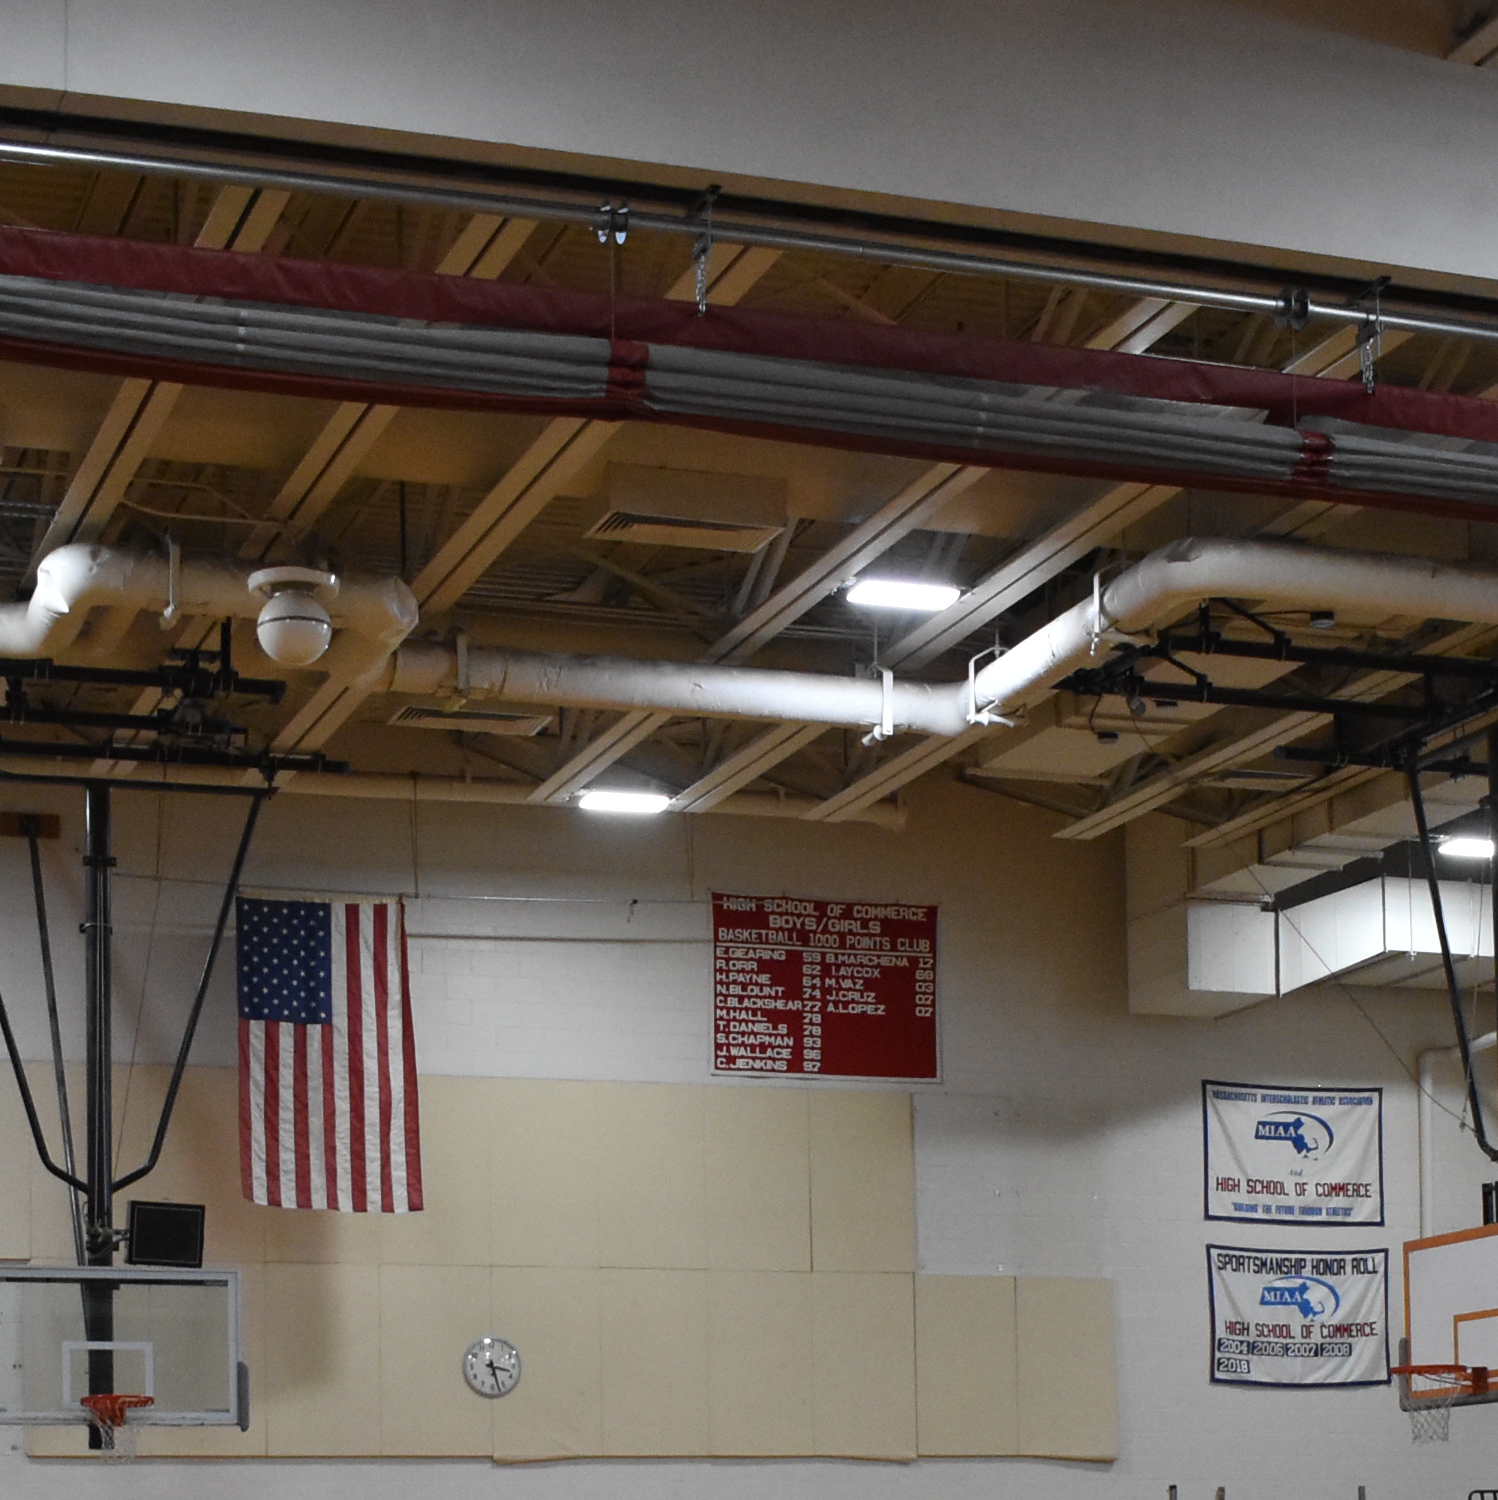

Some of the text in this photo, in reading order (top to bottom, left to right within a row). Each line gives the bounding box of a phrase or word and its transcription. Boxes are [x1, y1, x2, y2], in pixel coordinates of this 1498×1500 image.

[723, 897, 927, 921] HIGH SCHOOL OF COMMERCE
[769, 915, 881, 934] BOYS/GIRLS
[719, 928, 929, 952] BASKETBALL 1000 POINTS CLUB
[803, 976, 821, 988] 64
[1258, 1125, 1296, 1137] MIAA
[1216, 1177, 1371, 1197] HIGH SCHOOL OF COMMERCE
[1217, 1253, 1378, 1275] SPORTSMANSHIP HONOR ROLL
[1263, 1290, 1301, 1302] MIAA
[1225, 1321, 1378, 1339] HIGH SCHOOL OF COMMERCE
[1220, 1340, 1248, 1353] 2004
[1287, 1343, 1316, 1355] 2007
[1219, 1359, 1248, 1372] 2018
